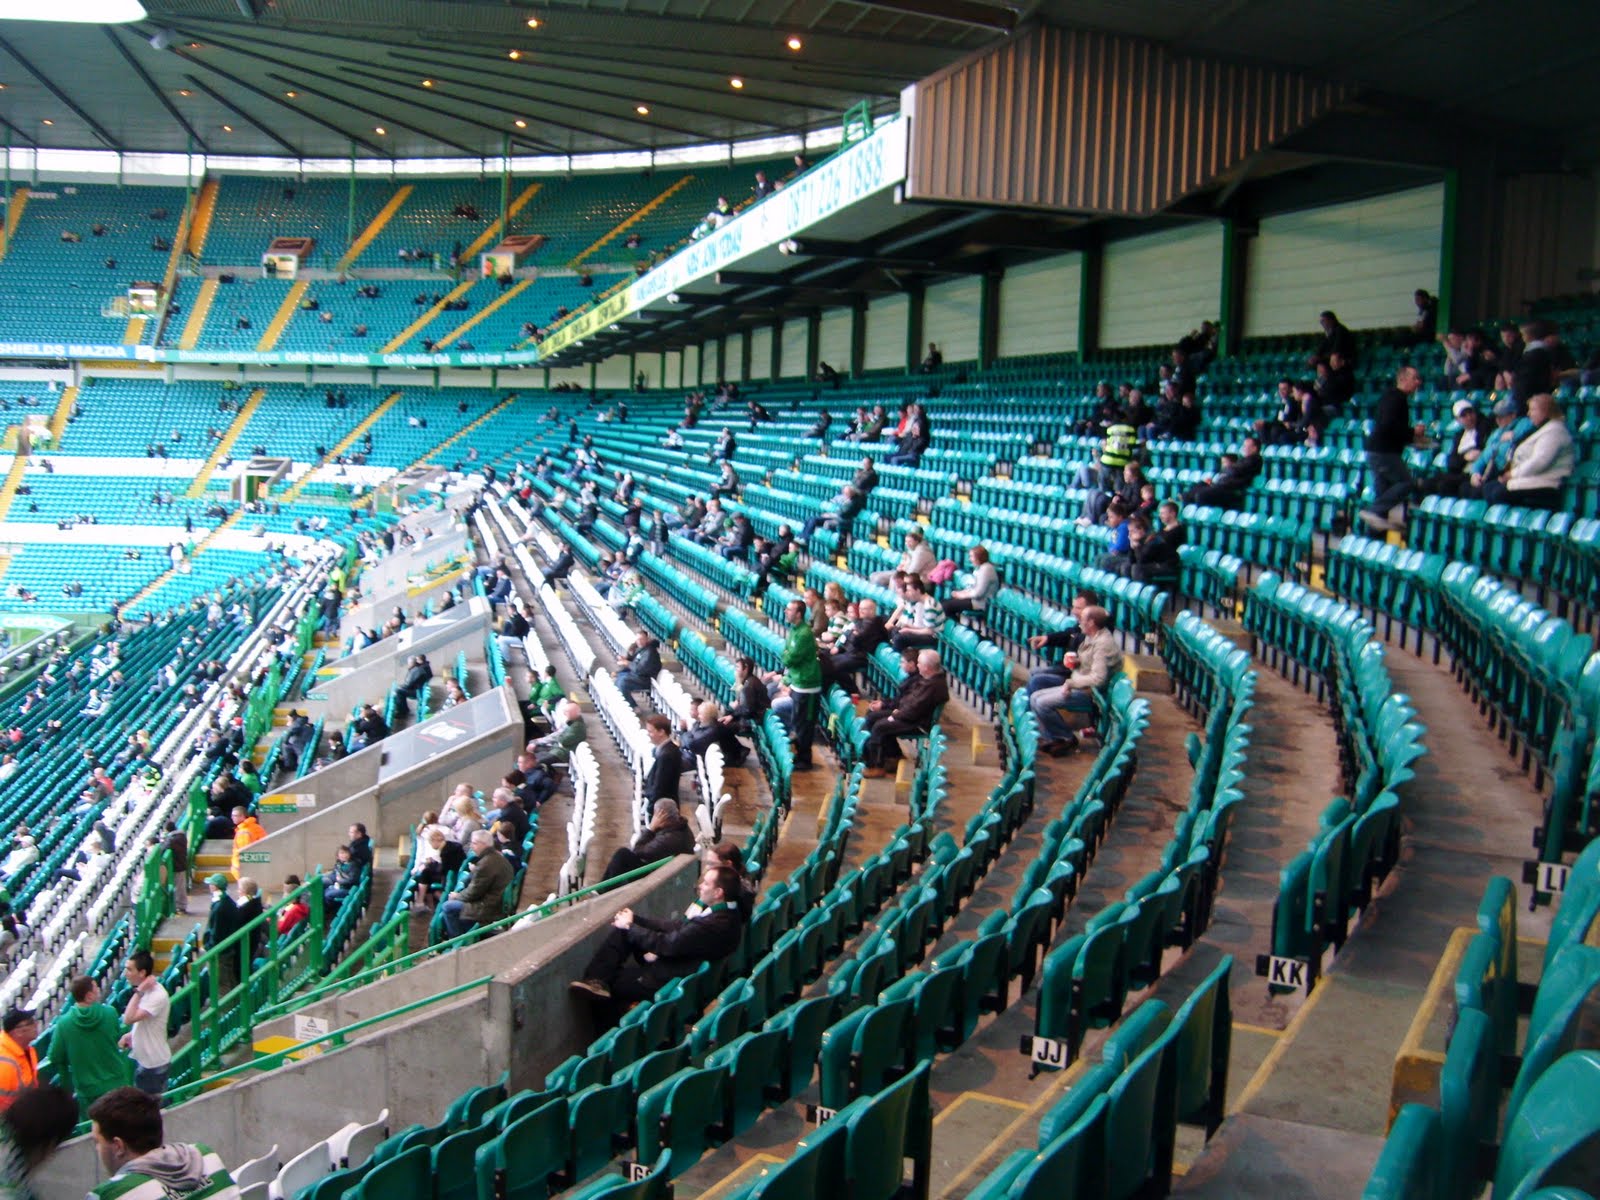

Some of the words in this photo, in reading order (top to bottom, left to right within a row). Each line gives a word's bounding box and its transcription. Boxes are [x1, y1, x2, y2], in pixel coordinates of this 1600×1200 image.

[848, 137, 883, 197] 1888
[69, 345, 128, 358] MAZDA
[285, 352, 312, 364] Celtic
[244, 853, 265, 862] EXIT
[1273, 960, 1303, 986] KK
[1038, 1041, 1062, 1064] JJ
